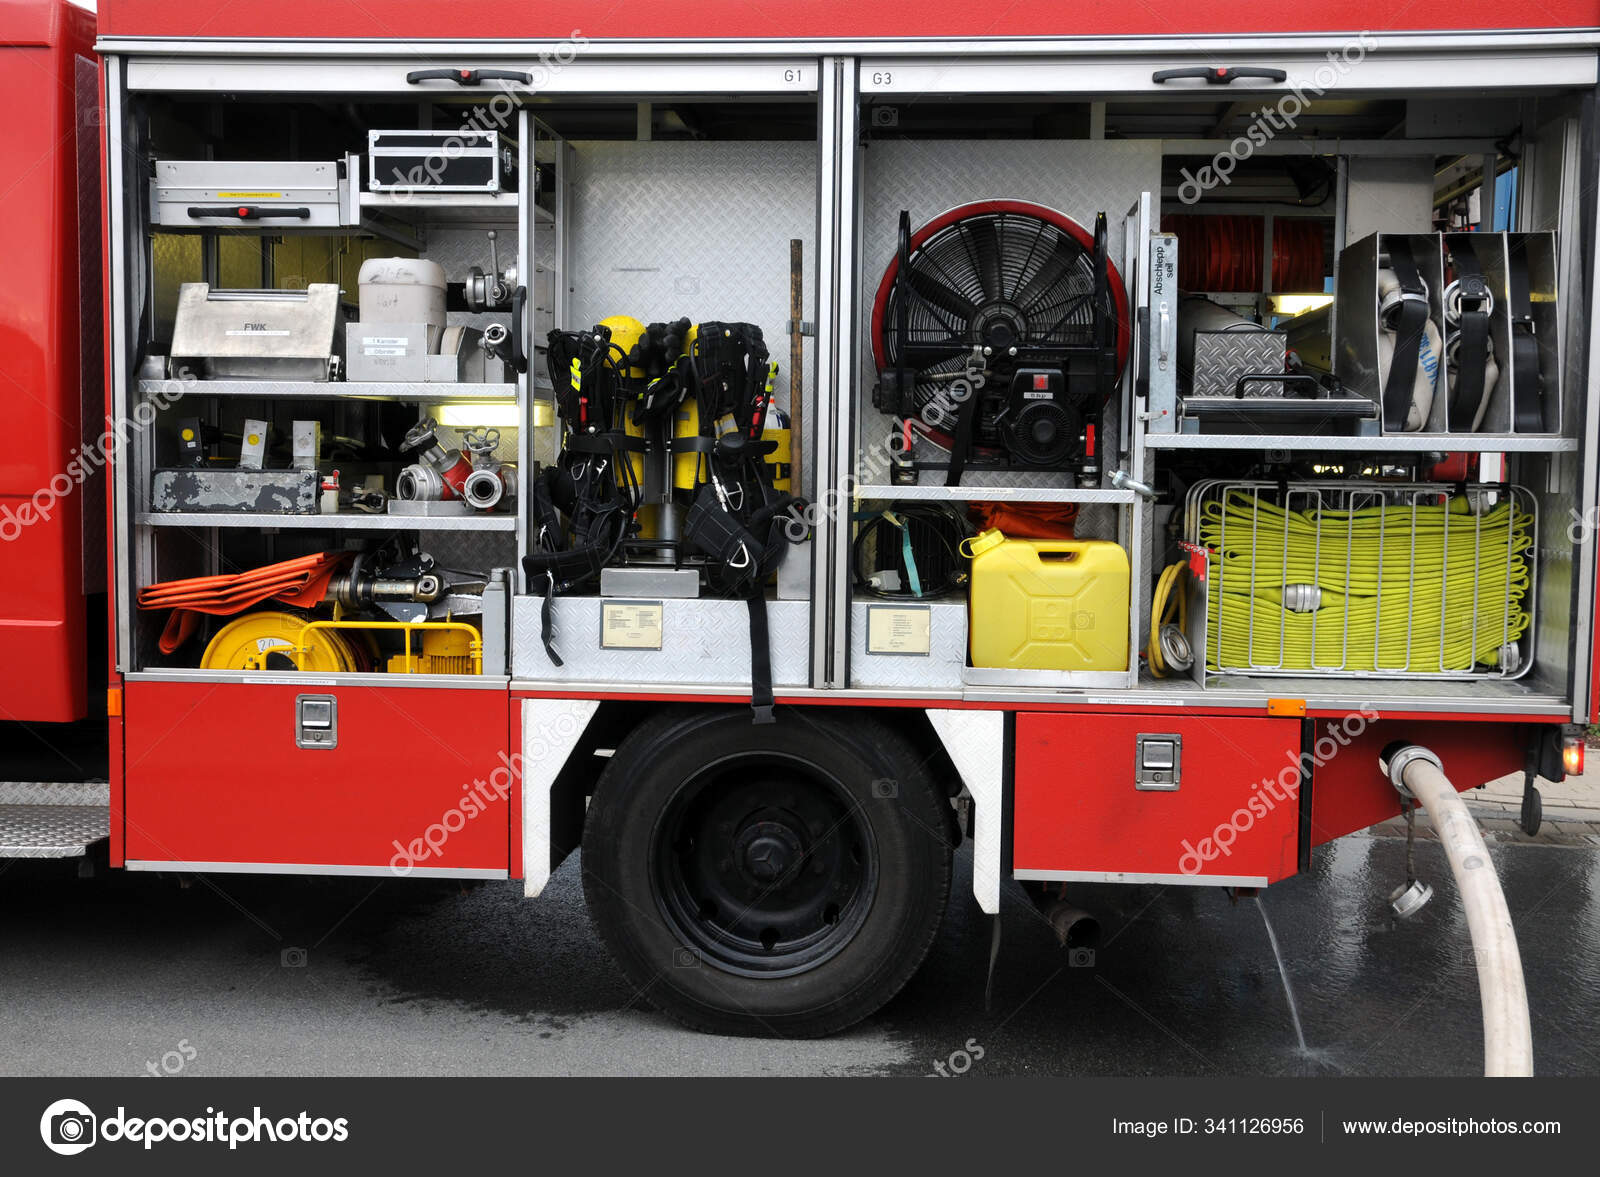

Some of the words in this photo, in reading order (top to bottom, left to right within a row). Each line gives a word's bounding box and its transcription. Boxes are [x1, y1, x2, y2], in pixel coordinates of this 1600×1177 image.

[784, 70, 801, 82] G1
[873, 72, 892, 85] G3
[1154, 246, 1165, 295] Abschlepp
